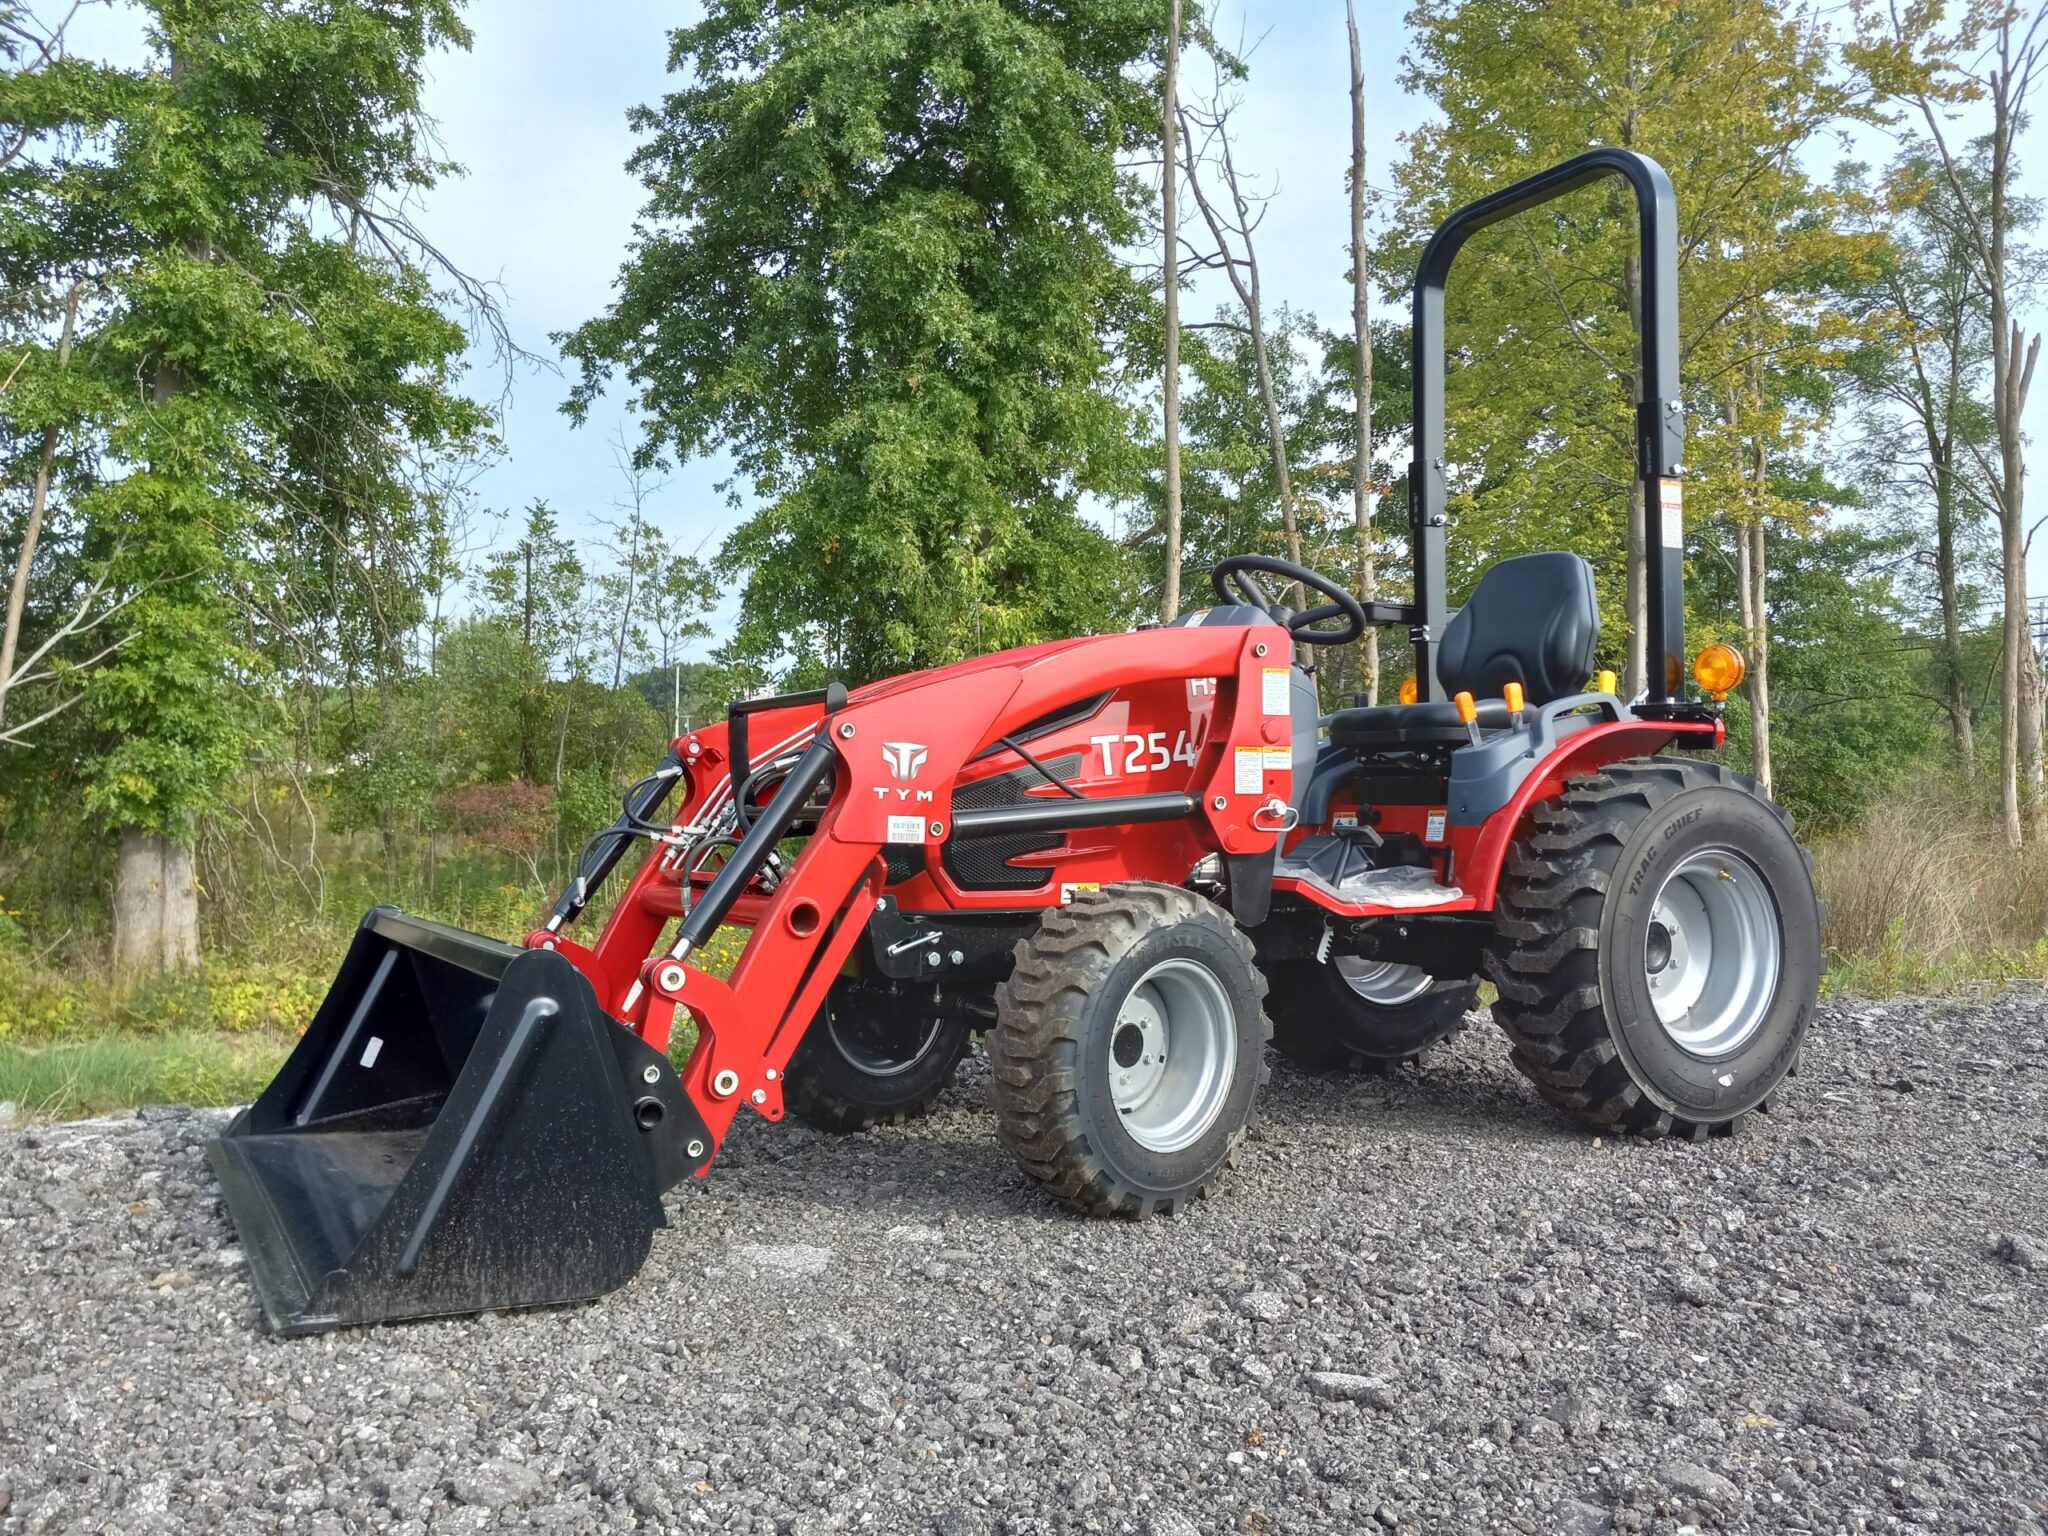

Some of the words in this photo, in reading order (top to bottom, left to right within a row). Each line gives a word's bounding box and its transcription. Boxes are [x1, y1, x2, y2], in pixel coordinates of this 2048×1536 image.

[1090, 730, 1196, 776] T254
[873, 786, 933, 803] TYM
[1629, 846, 1657, 896] TRAC
[1664, 807, 1703, 841] CHIEF
